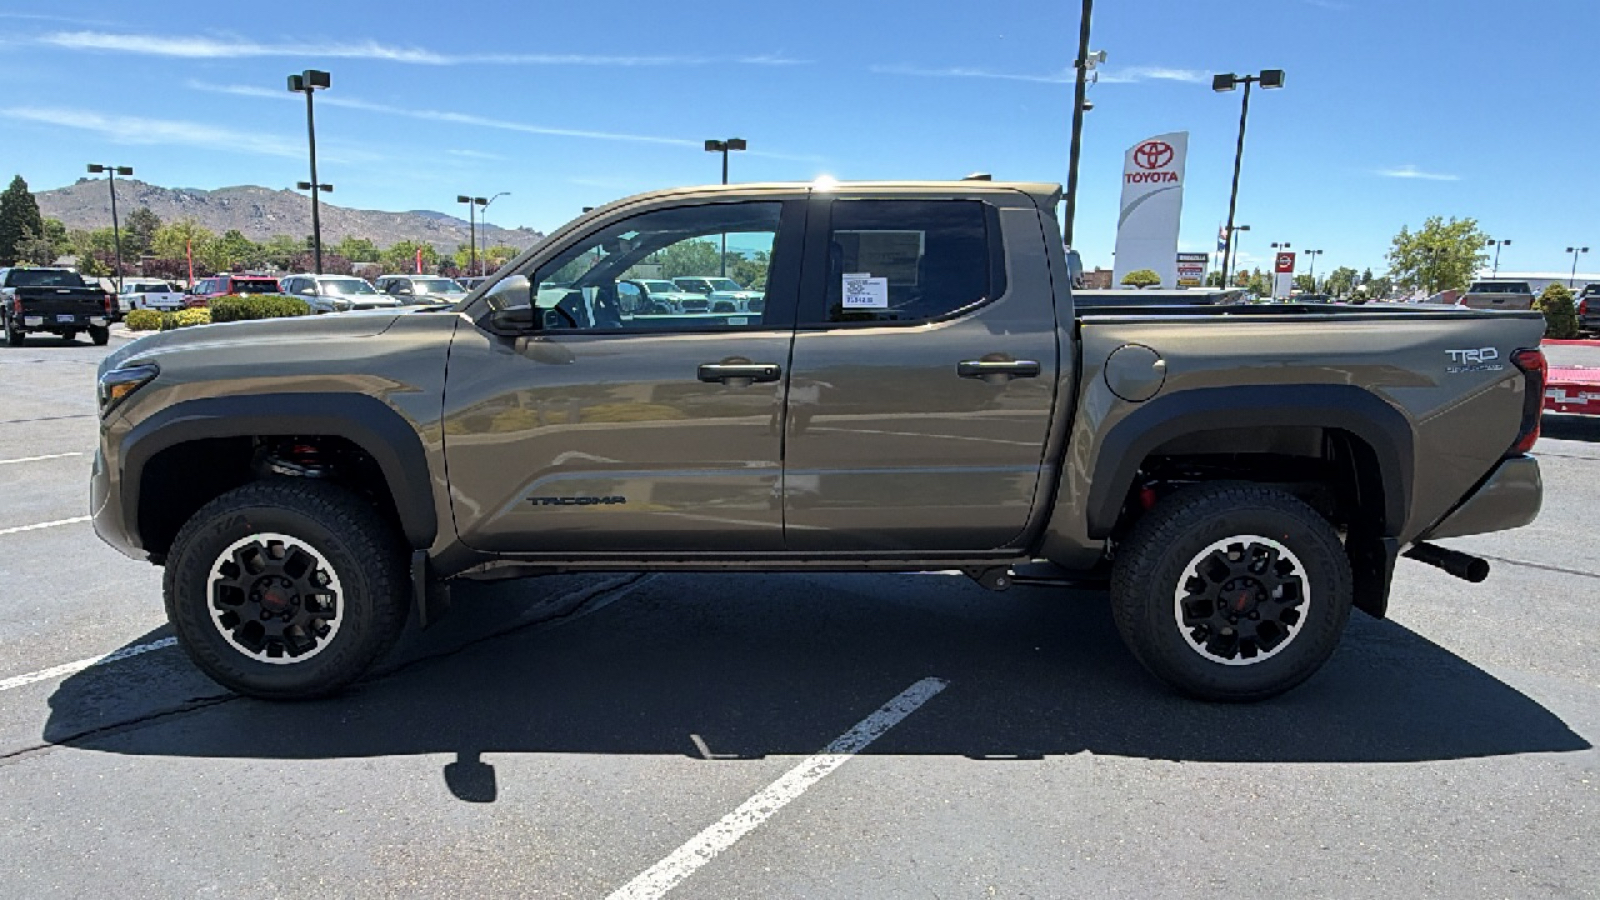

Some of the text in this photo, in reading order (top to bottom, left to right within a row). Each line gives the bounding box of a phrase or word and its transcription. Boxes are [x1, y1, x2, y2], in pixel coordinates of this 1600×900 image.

[1125, 171, 1178, 184] TOYOTA
[1444, 347, 1499, 365] TRD
[526, 496, 626, 506] TACOMA
